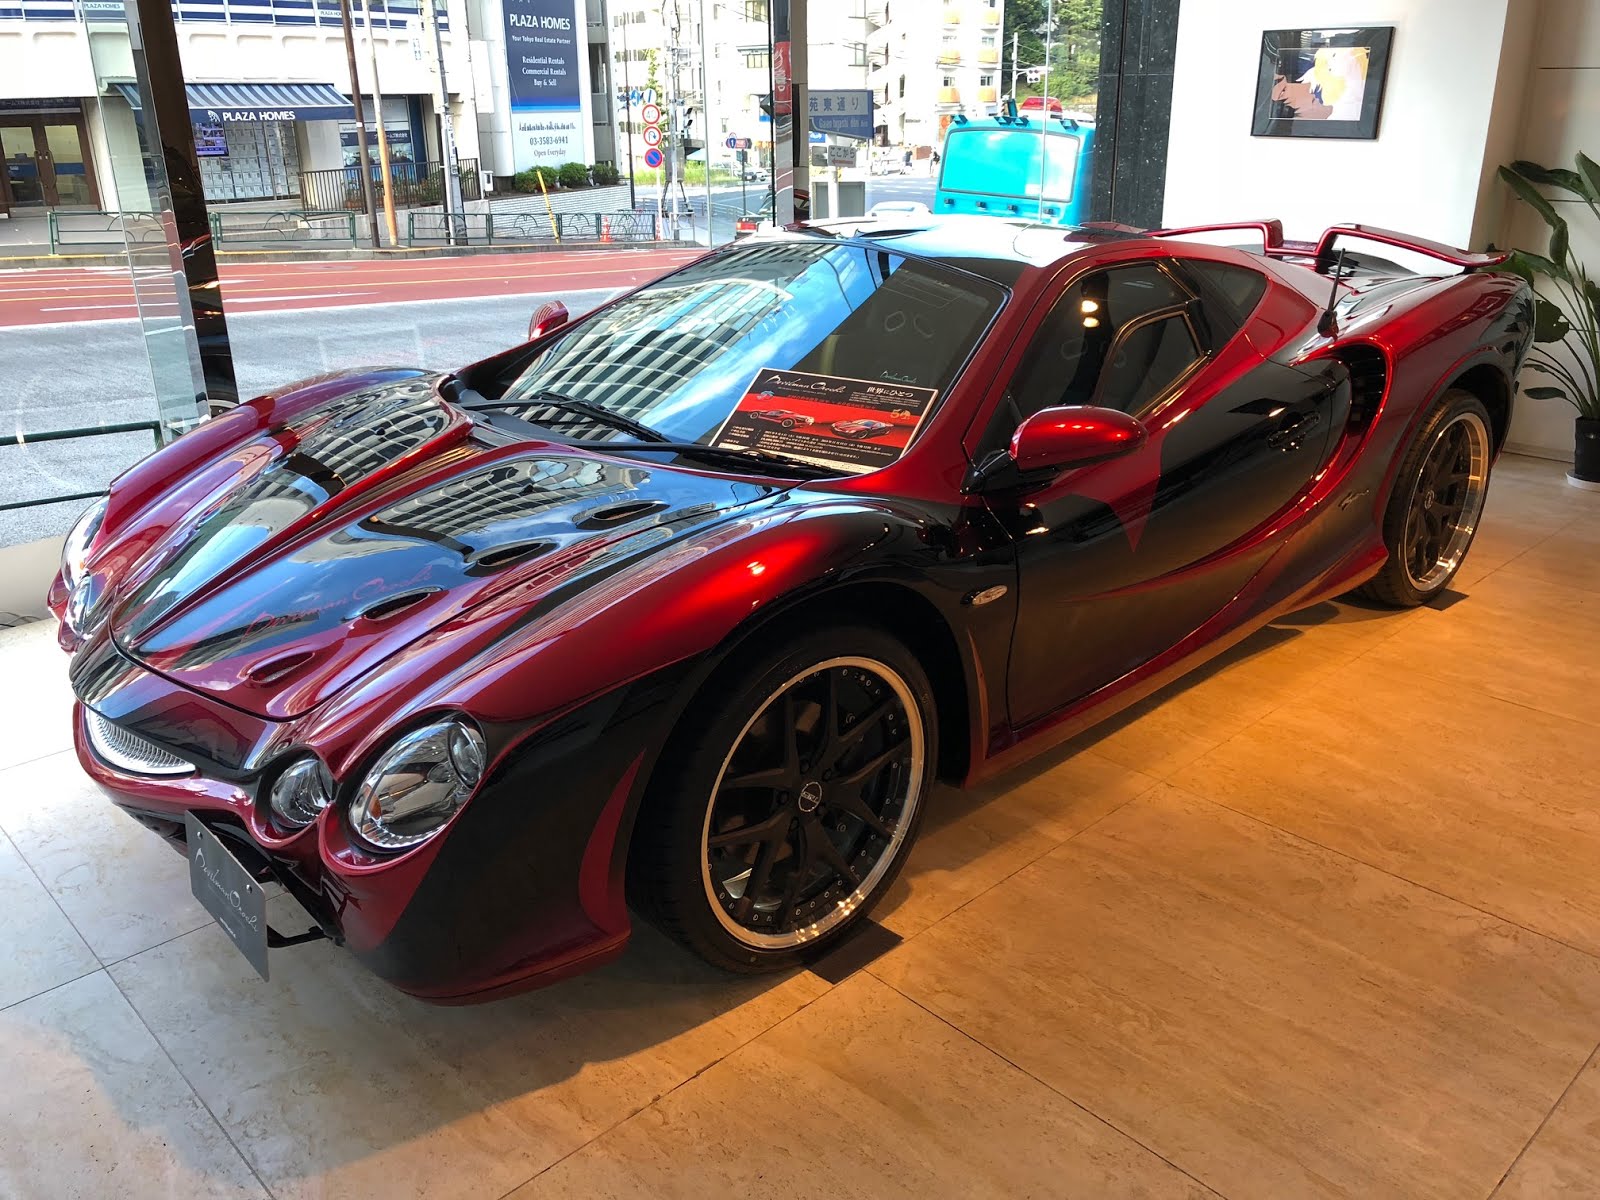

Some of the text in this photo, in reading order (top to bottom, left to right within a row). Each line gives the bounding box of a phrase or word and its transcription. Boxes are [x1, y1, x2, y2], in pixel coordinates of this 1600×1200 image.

[509, 13, 571, 30] PLAZA HOMES
[522, 35, 534, 43] Tokyo
[522, 56, 565, 65] Residential Rentals
[522, 67, 549, 75] Commercial
[533, 79, 543, 88] Buy
[222, 111, 296, 121] PLAZA HOMES
[529, 136, 569, 146] 03-3583-6941
[533, 148, 566, 158] Open Everyday
[829, 147, 856, 159] ここから
